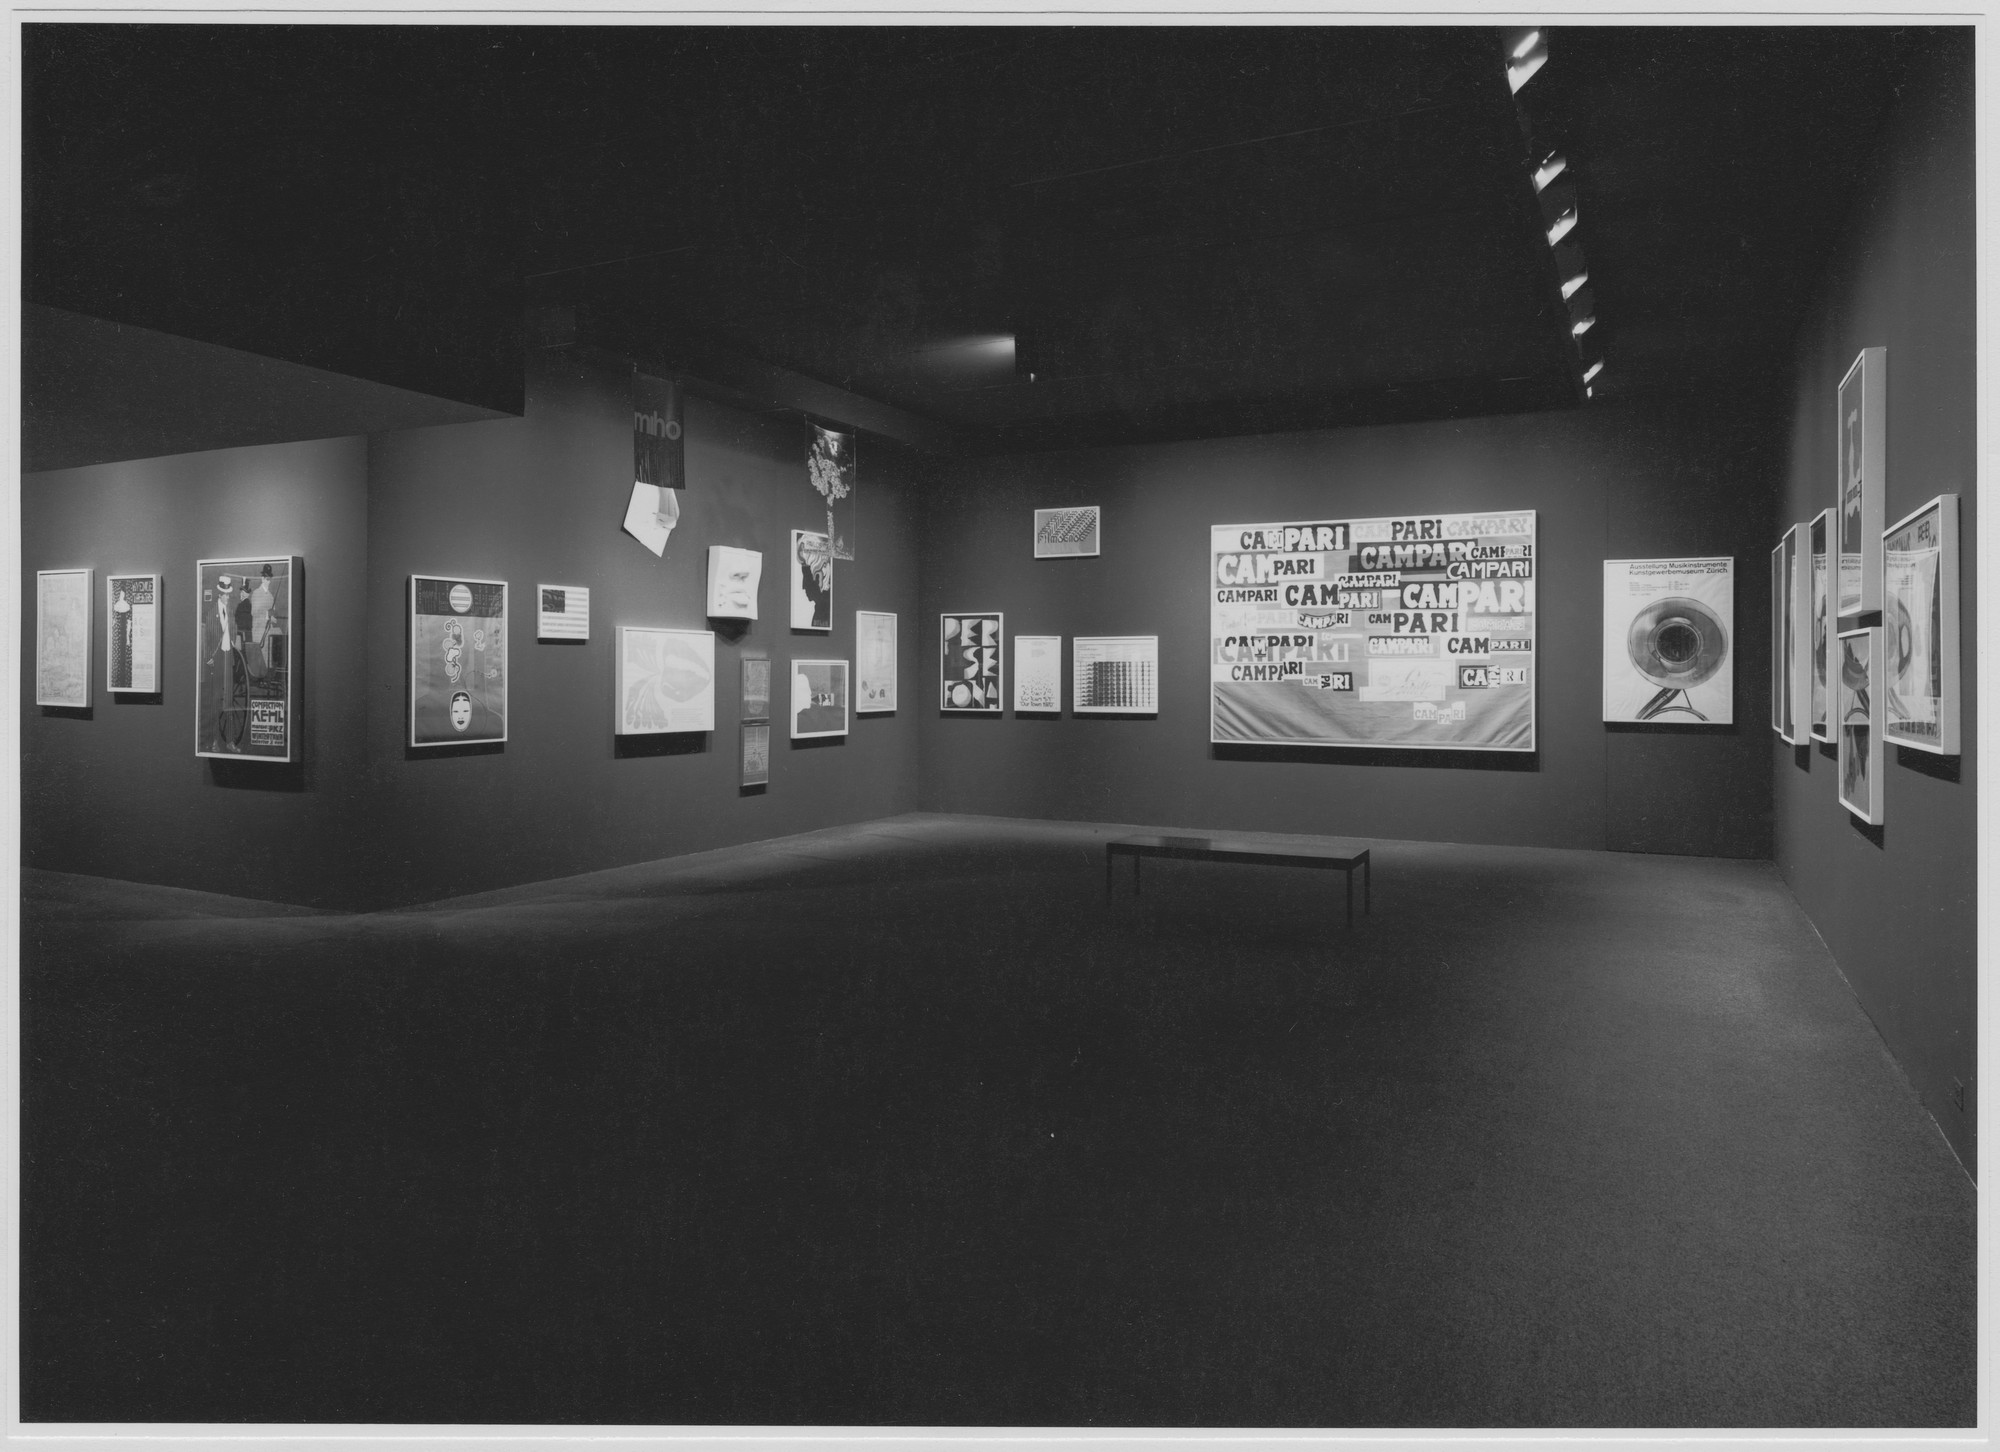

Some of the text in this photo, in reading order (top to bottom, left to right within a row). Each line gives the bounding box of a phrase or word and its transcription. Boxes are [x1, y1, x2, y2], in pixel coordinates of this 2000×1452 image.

[1447, 561, 1529, 579] CAMPARI
[1669, 561, 1727, 569] Musikinstrumente
[1629, 568, 1704, 576] Kunstgewerbemuseum
[1217, 589, 1278, 603] CAMPARI
[252, 710, 283, 723] KEHL
